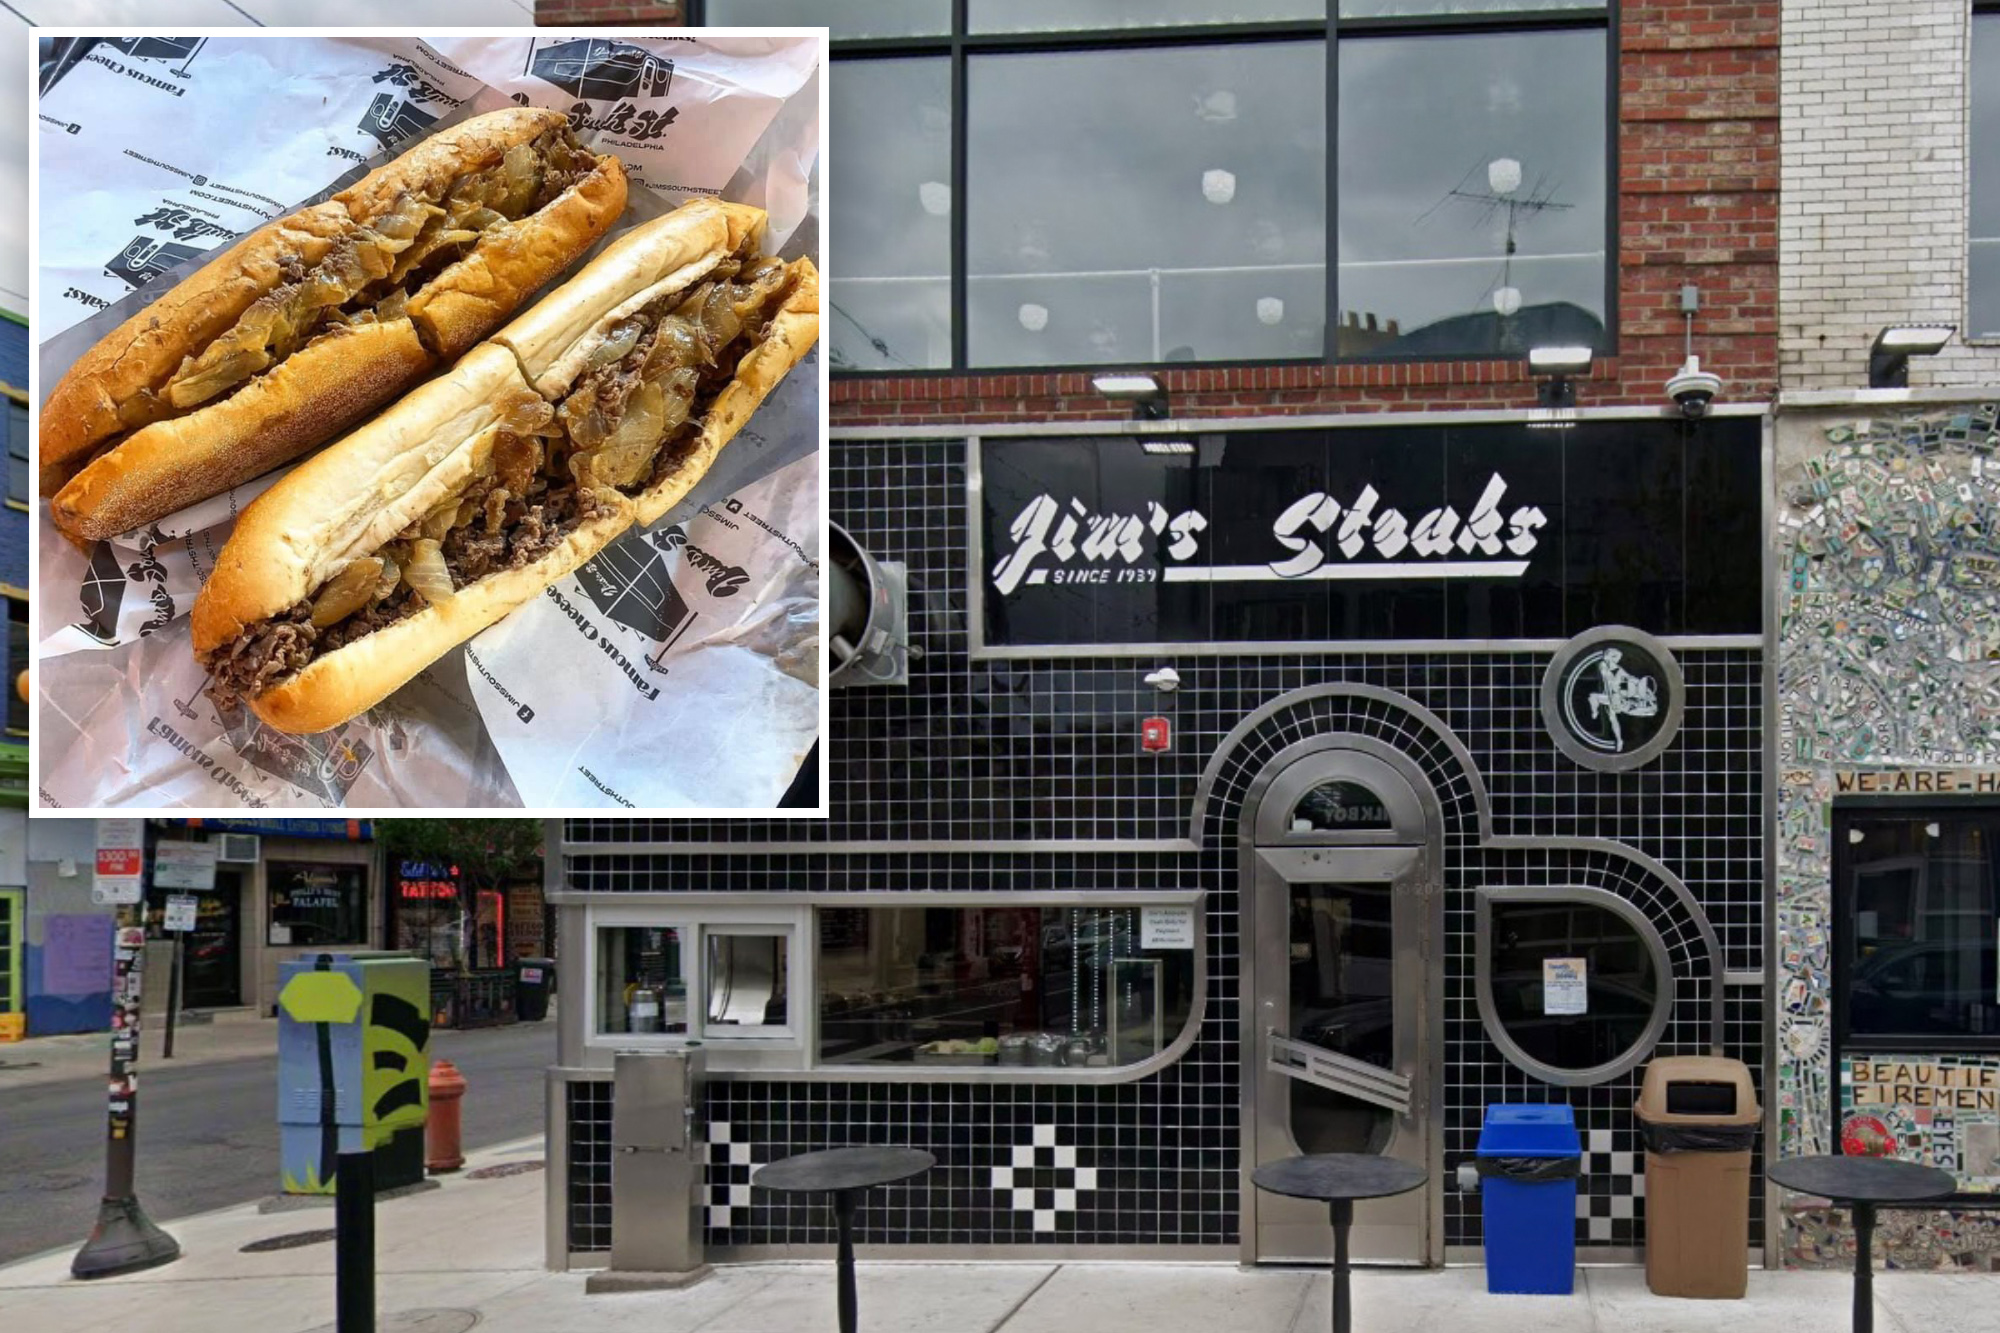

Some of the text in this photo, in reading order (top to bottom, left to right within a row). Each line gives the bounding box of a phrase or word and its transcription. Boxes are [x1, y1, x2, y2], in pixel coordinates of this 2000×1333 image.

[600, 137, 665, 152] PHILADELPHIA
[992, 471, 1548, 596] Jim's Steaks
[1053, 568, 1158, 585] SINCE 1939
[597, 636, 661, 702] Famous
[400, 880, 457, 898] TATTOO
[292, 897, 339, 908] FALAFEL
[1851, 1085, 1995, 1110] FIREMEN
[1932, 1117, 1954, 1166] EYES
